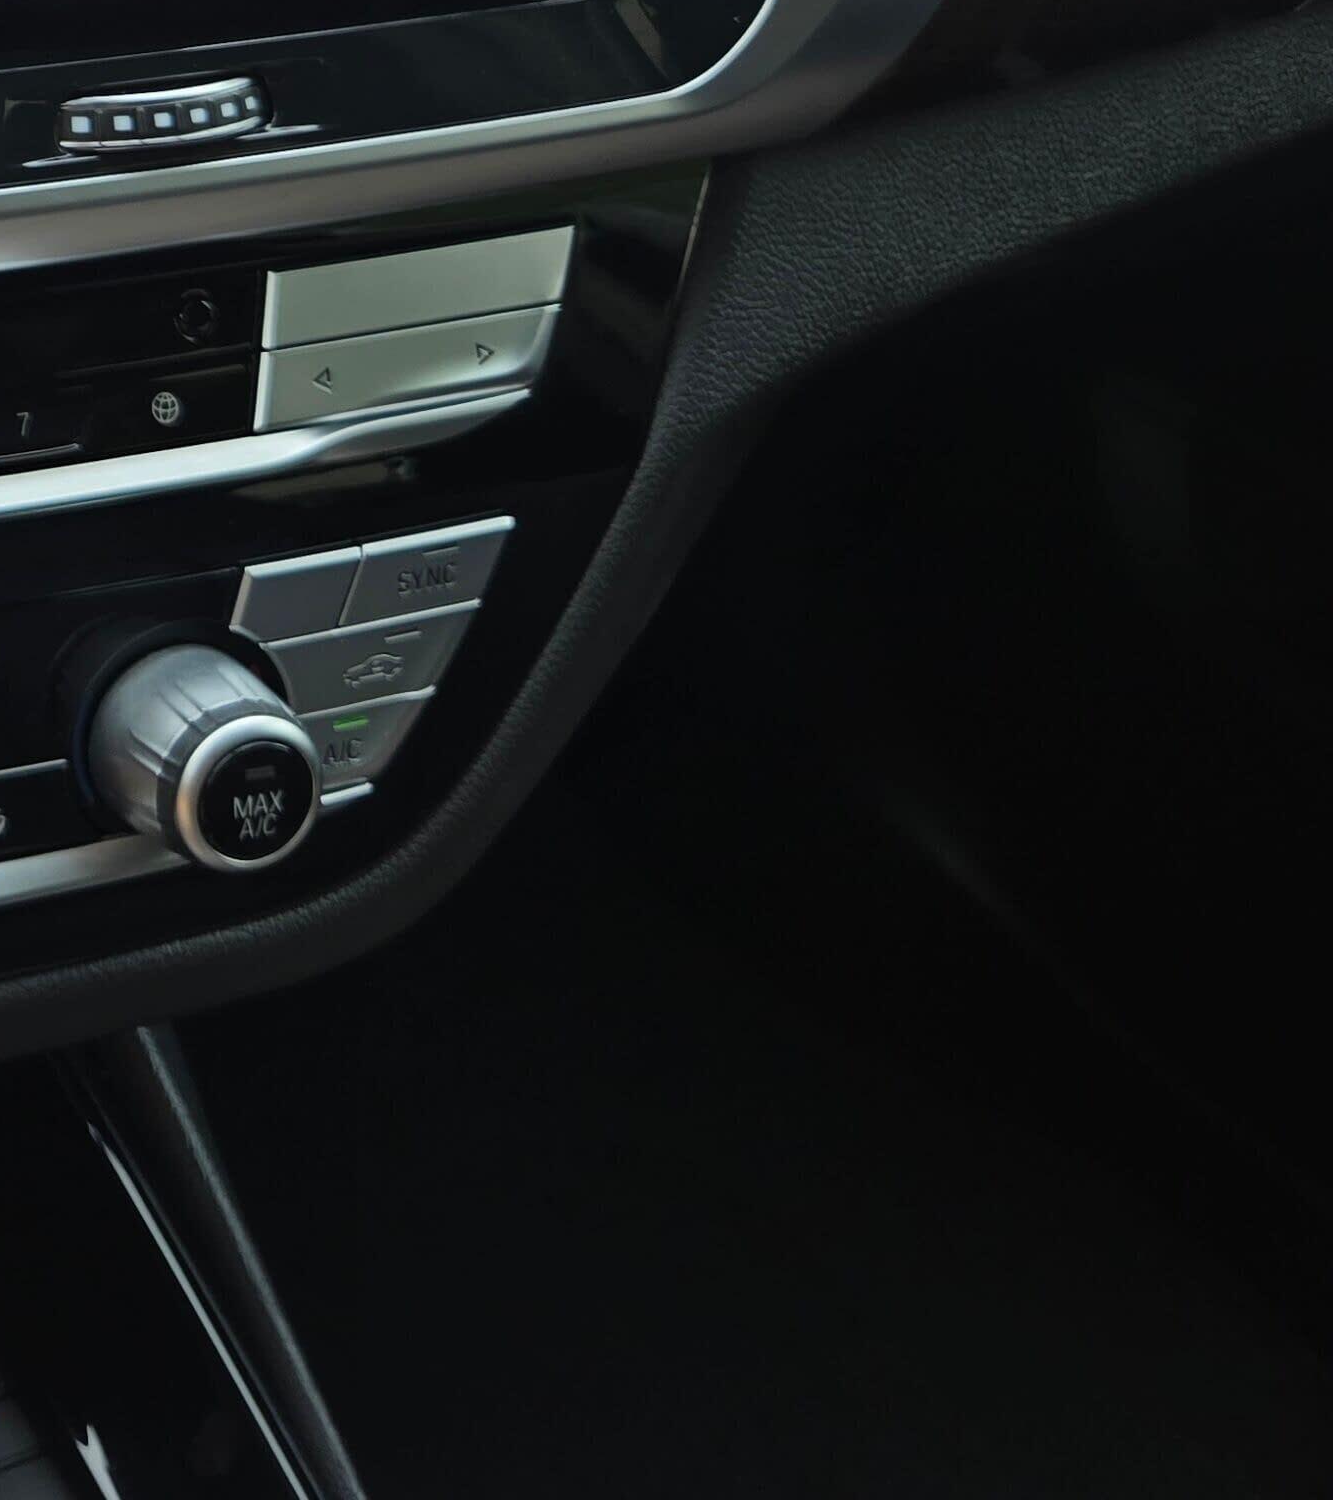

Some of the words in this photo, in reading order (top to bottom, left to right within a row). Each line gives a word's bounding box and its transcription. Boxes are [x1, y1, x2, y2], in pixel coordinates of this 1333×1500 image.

[15, 411, 33, 438] 7
[396, 562, 458, 598] SYNC
[233, 790, 285, 820] MAX
[238, 813, 278, 841] A/C
